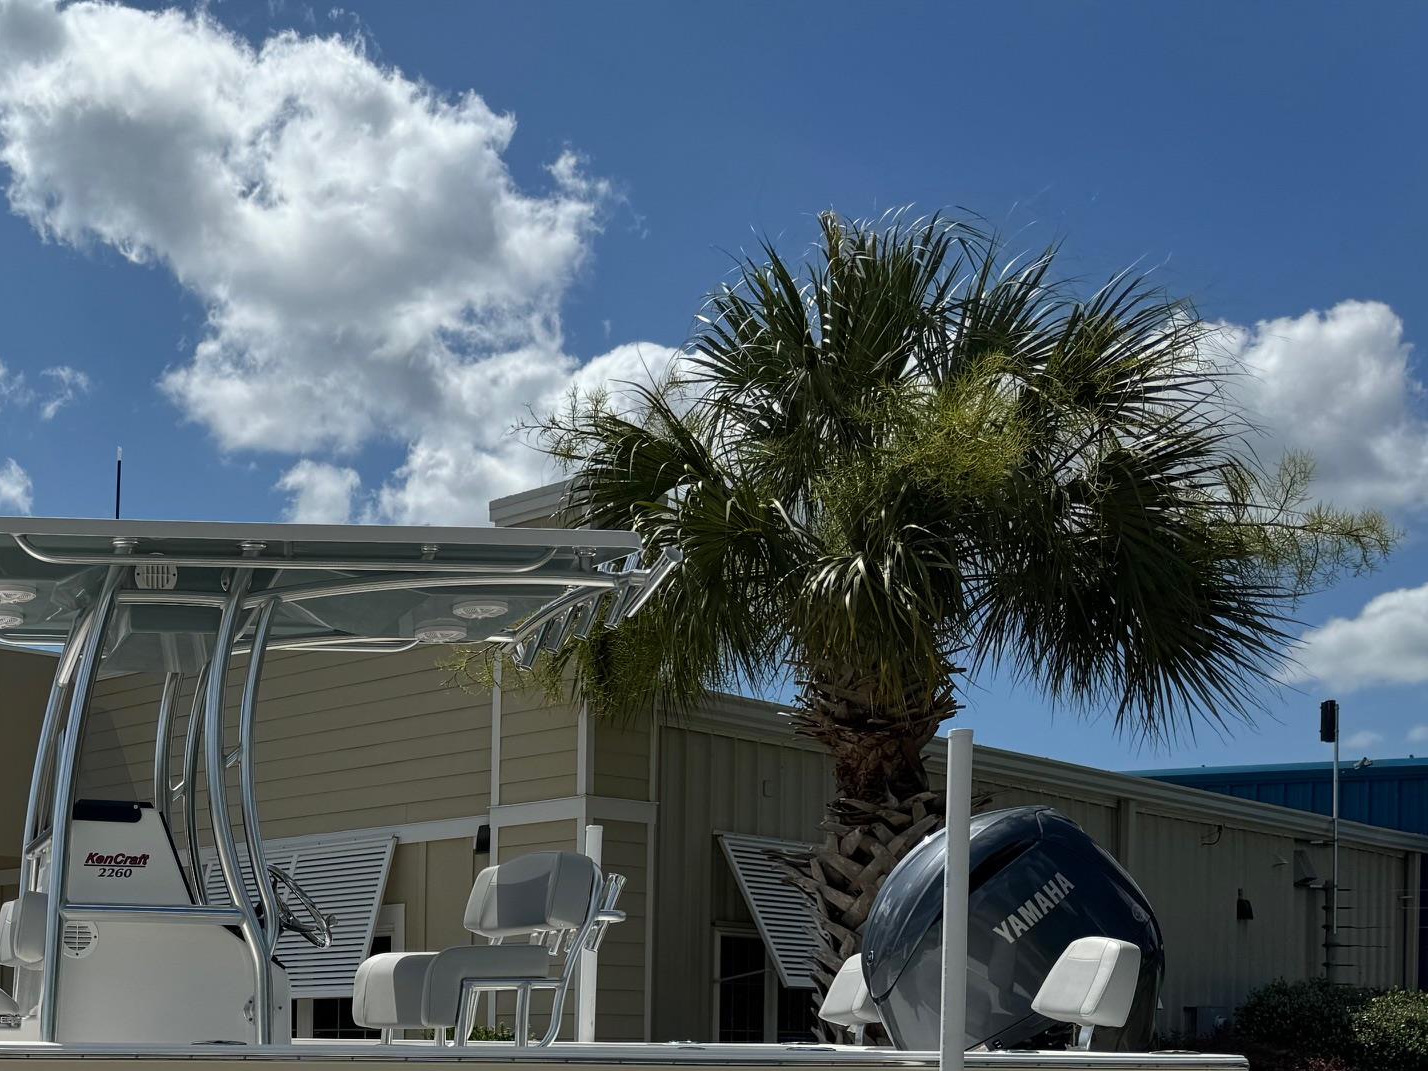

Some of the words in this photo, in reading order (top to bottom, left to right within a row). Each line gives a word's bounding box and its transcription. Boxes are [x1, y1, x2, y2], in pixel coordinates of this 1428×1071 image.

[84, 852, 150, 866] KenCraft
[97, 867, 133, 878] 2260
[992, 871, 1075, 944] YAMAHA
